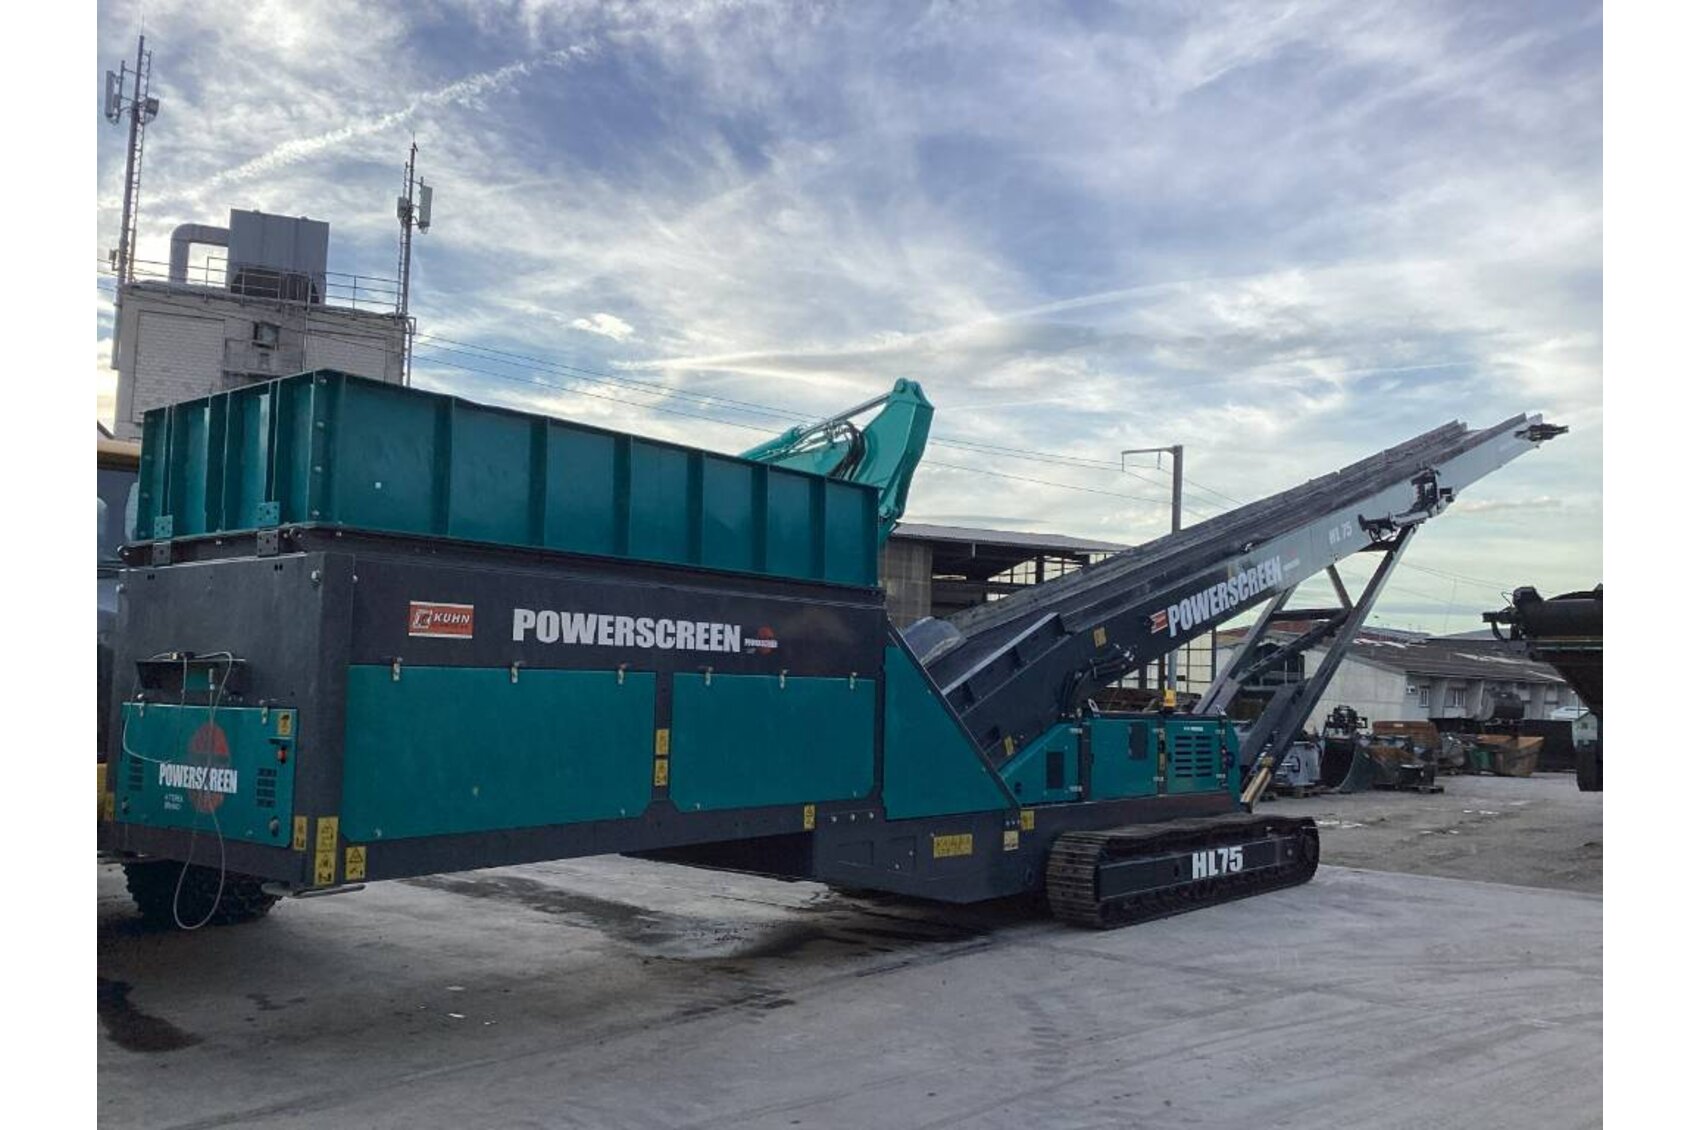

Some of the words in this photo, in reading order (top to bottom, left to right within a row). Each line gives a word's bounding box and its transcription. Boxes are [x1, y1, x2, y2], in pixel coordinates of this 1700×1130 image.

[1341, 520, 1352, 539] 75
[1167, 556, 1282, 638] POWERSCREEN
[433, 612, 470, 624] KUHN
[513, 608, 741, 652] POWERSCREEN
[1192, 846, 1242, 879] HL75
